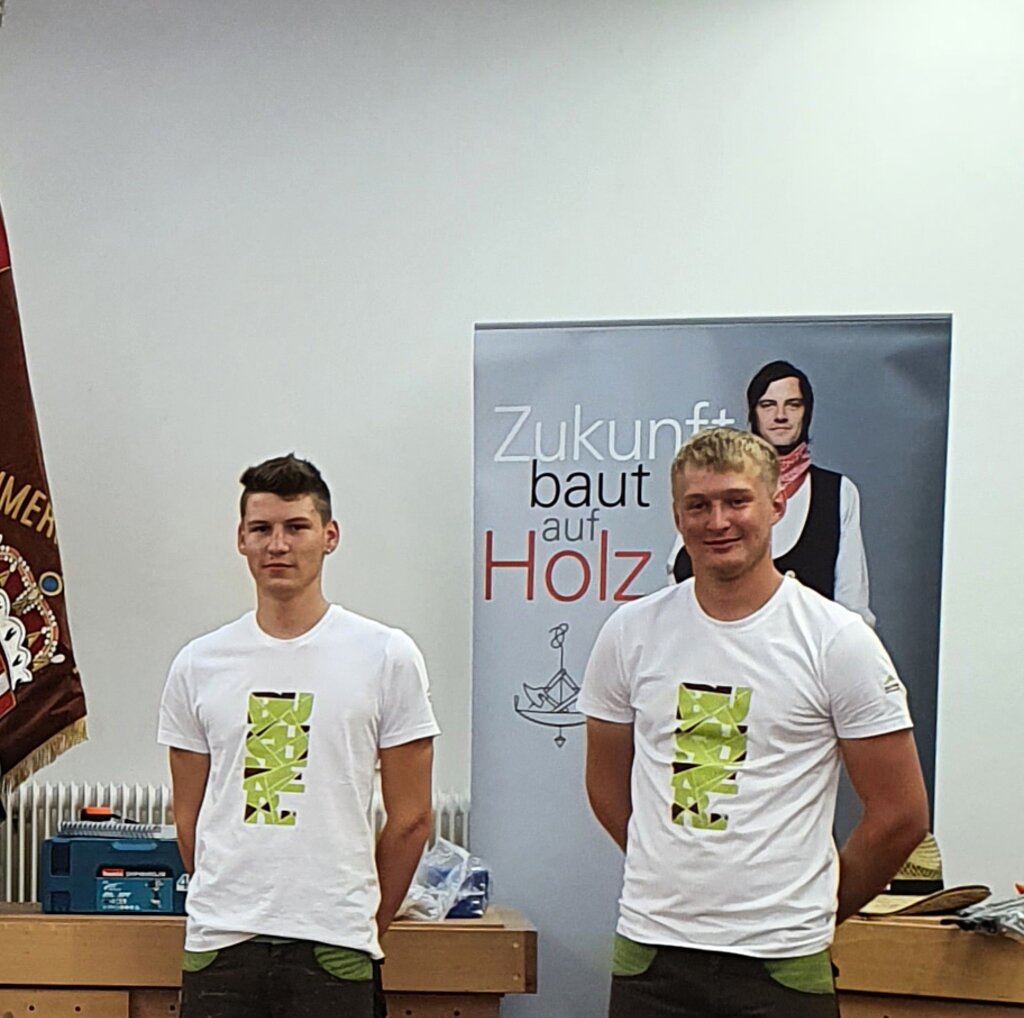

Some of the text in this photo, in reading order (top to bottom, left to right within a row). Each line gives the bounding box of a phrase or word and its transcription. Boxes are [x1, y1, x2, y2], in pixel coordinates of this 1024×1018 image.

[530, 459, 651, 508] baut
[542, 508, 600, 542] auf
[484, 529, 652, 602] Holz
